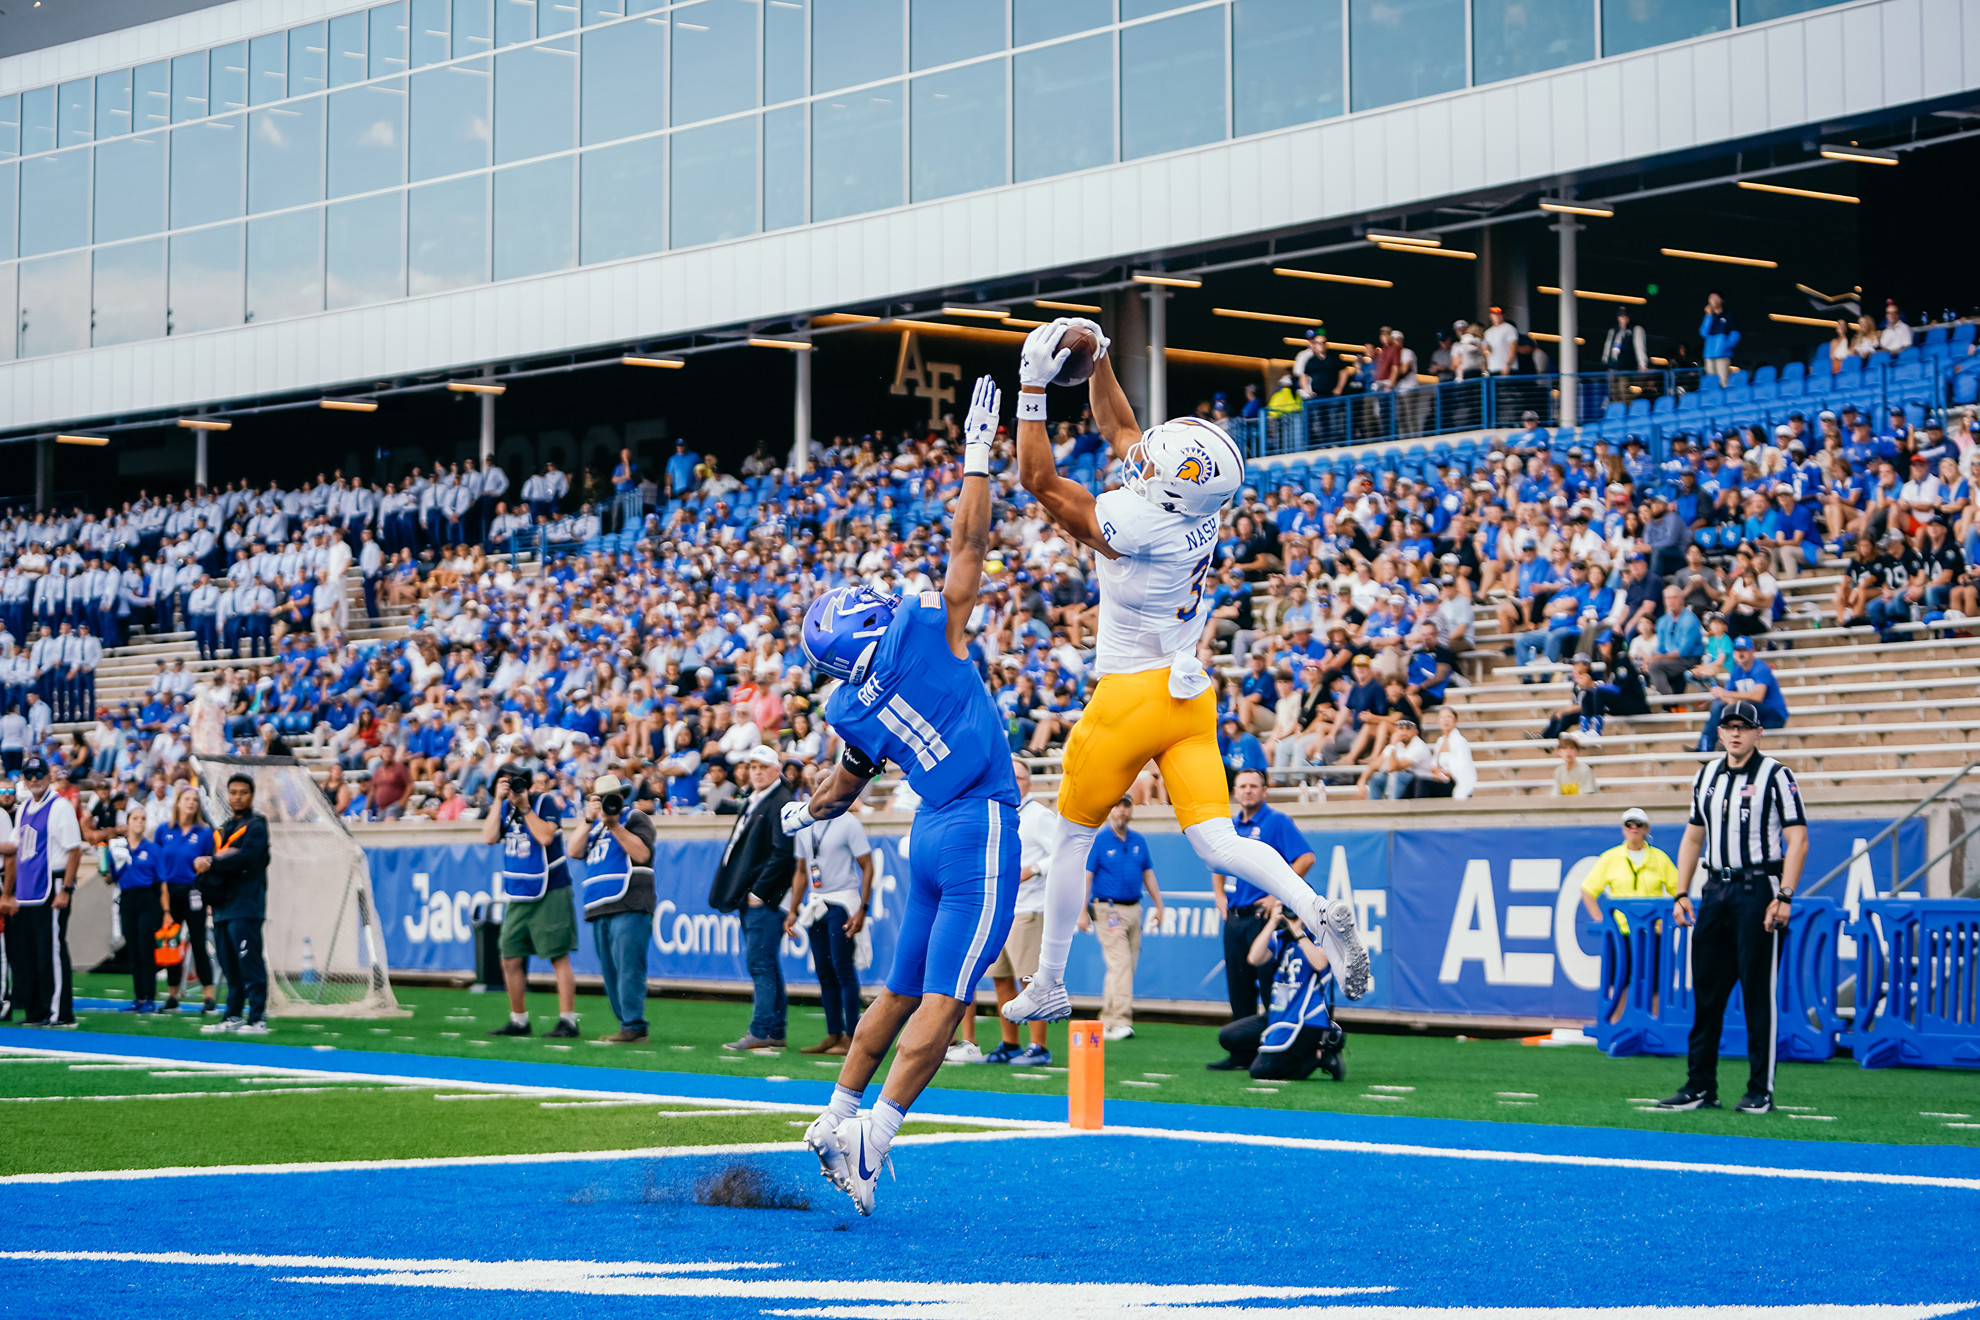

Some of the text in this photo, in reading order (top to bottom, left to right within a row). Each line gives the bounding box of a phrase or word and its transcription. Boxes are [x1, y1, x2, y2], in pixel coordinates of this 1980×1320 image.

[889, 330, 961, 430] AF
[1185, 517, 1218, 551] NASH
[1176, 552, 1211, 623] 3
[857, 671, 884, 707] GOFF
[877, 693, 951, 772] 11
[1142, 907, 1222, 936] ARTIN
[1837, 838, 1921, 960] A
